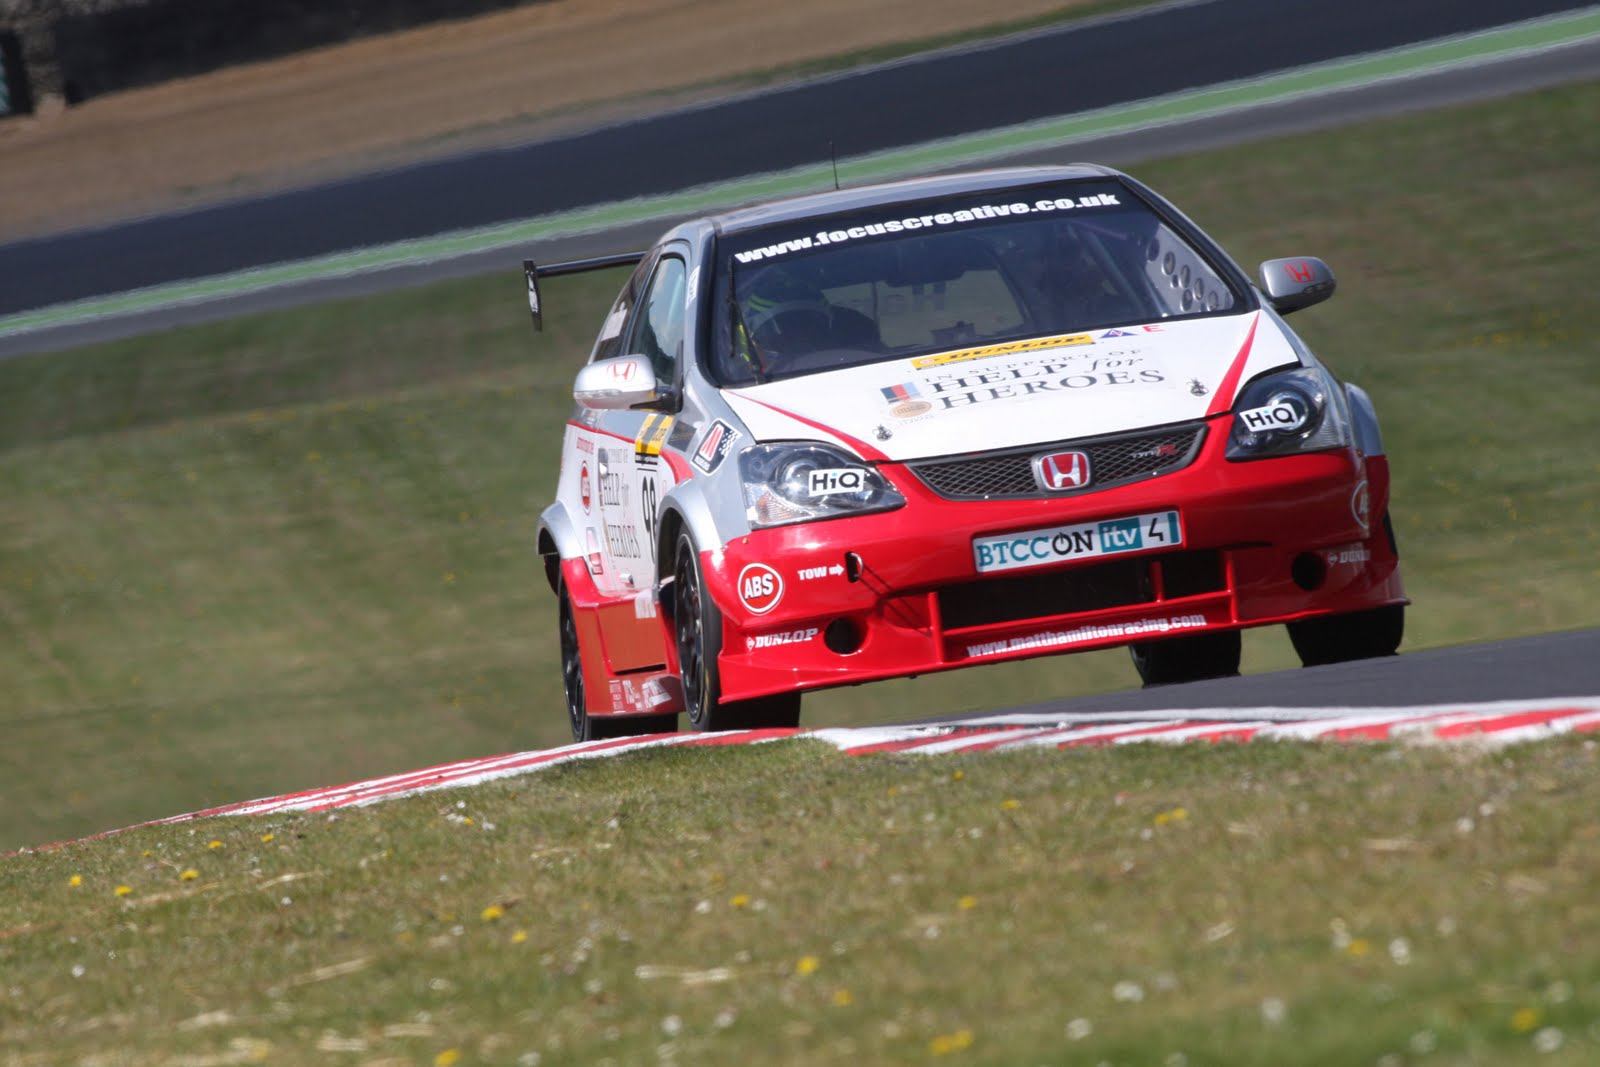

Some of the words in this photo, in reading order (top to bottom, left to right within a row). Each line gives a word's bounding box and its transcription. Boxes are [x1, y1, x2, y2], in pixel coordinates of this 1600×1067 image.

[734, 193, 1121, 264] www.focuscreative.co.uk
[948, 336, 1087, 360] DUNLOP
[932, 364, 1068, 393] HELP
[1084, 358, 1144, 373] for
[969, 353, 1090, 374] SUPPORT
[940, 369, 1166, 410] HEROES
[1244, 406, 1295, 428] HiQ
[811, 471, 860, 491] HiQ
[1102, 526, 1138, 549] itv
[1147, 517, 1165, 543] 4
[797, 566, 828, 580] TOW
[743, 573, 774, 600] ABS
[754, 627, 819, 648] DUNLOP
[966, 613, 1208, 658] www.matthamiltonracing.com
